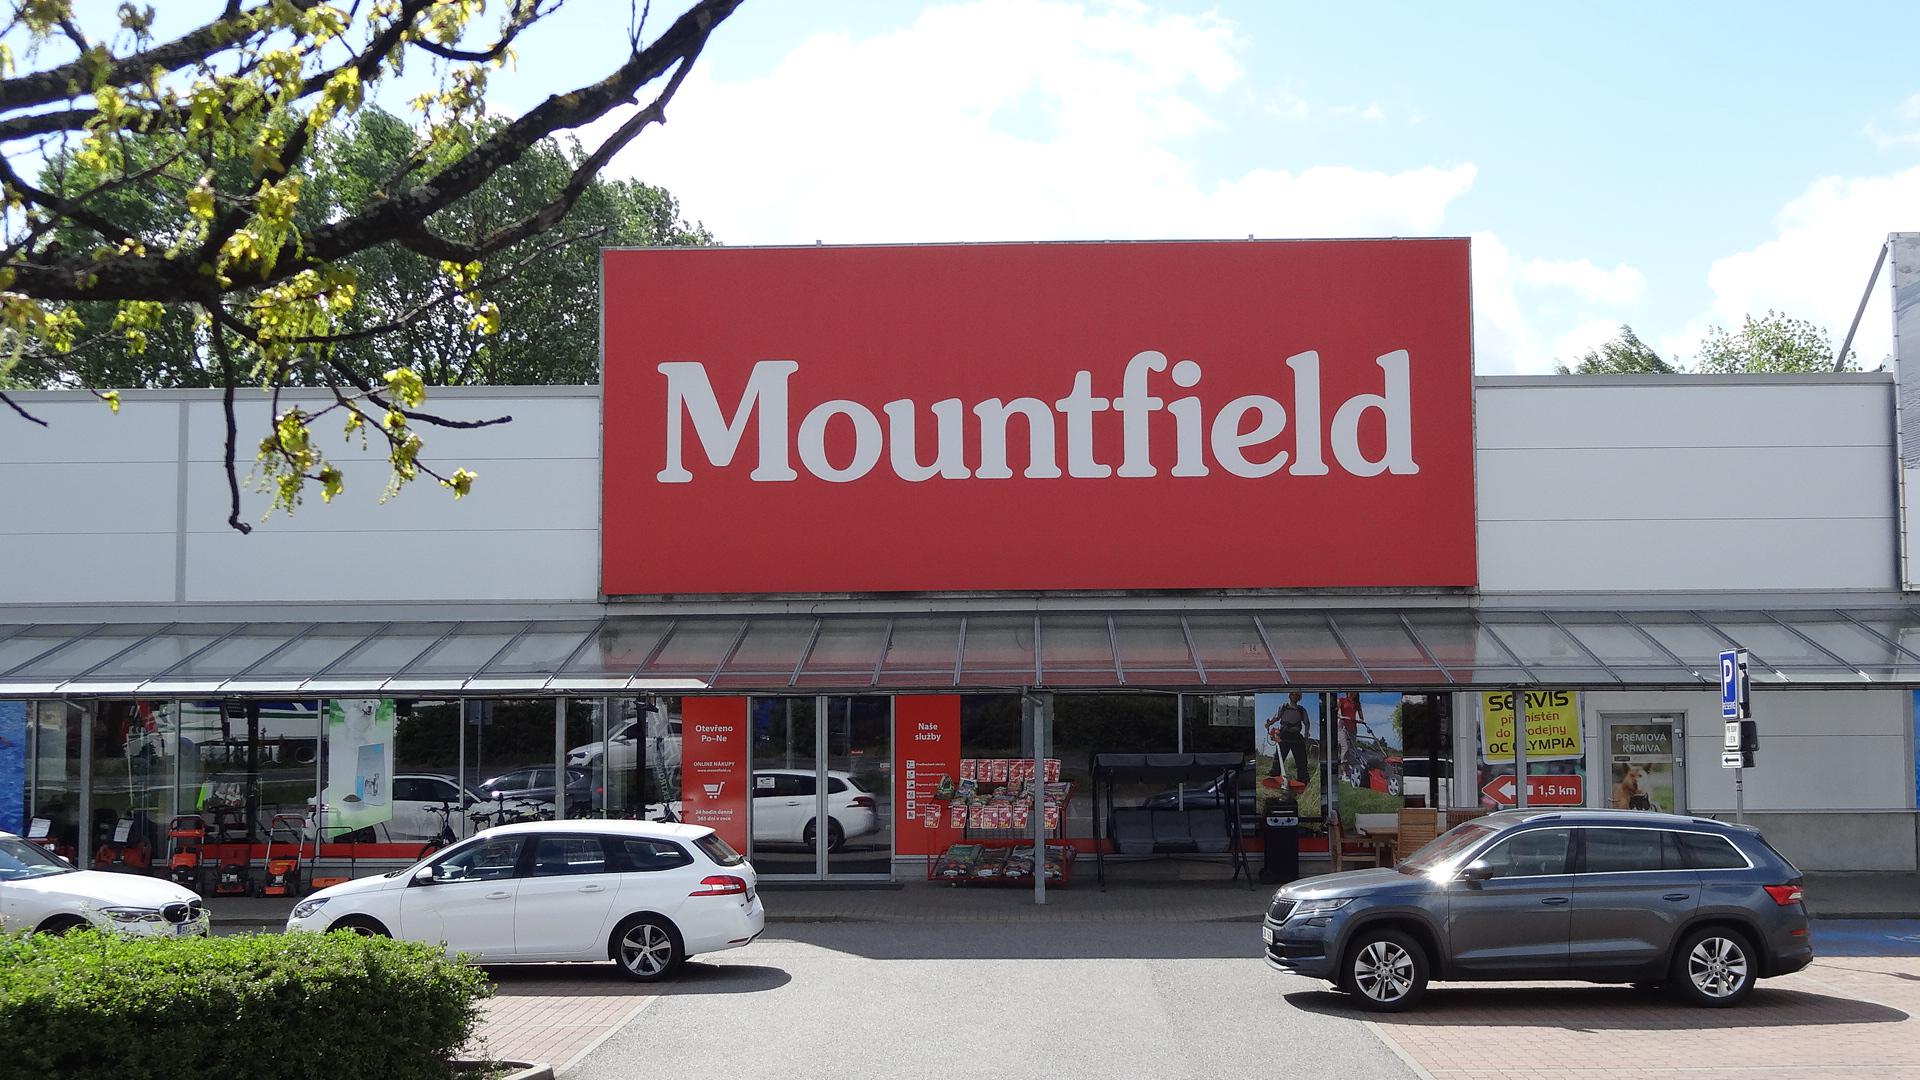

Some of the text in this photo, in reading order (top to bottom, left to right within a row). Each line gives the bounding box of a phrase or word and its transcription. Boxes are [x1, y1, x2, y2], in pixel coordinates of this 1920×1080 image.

[657, 349, 1420, 483] Mountfield
[1723, 659, 1733, 697] P
[695, 724, 734, 733] Otevřeno
[918, 722, 938, 730] Naše
[1495, 725, 1567, 738] do odejny
[914, 733, 942, 742] služby
[1615, 732, 1667, 742] PRÉMIOVÁ
[1489, 737, 1576, 754] OC YMPIA
[1622, 744, 1661, 753] KRMIVA
[1538, 785, 1577, 797] 1,5 km
